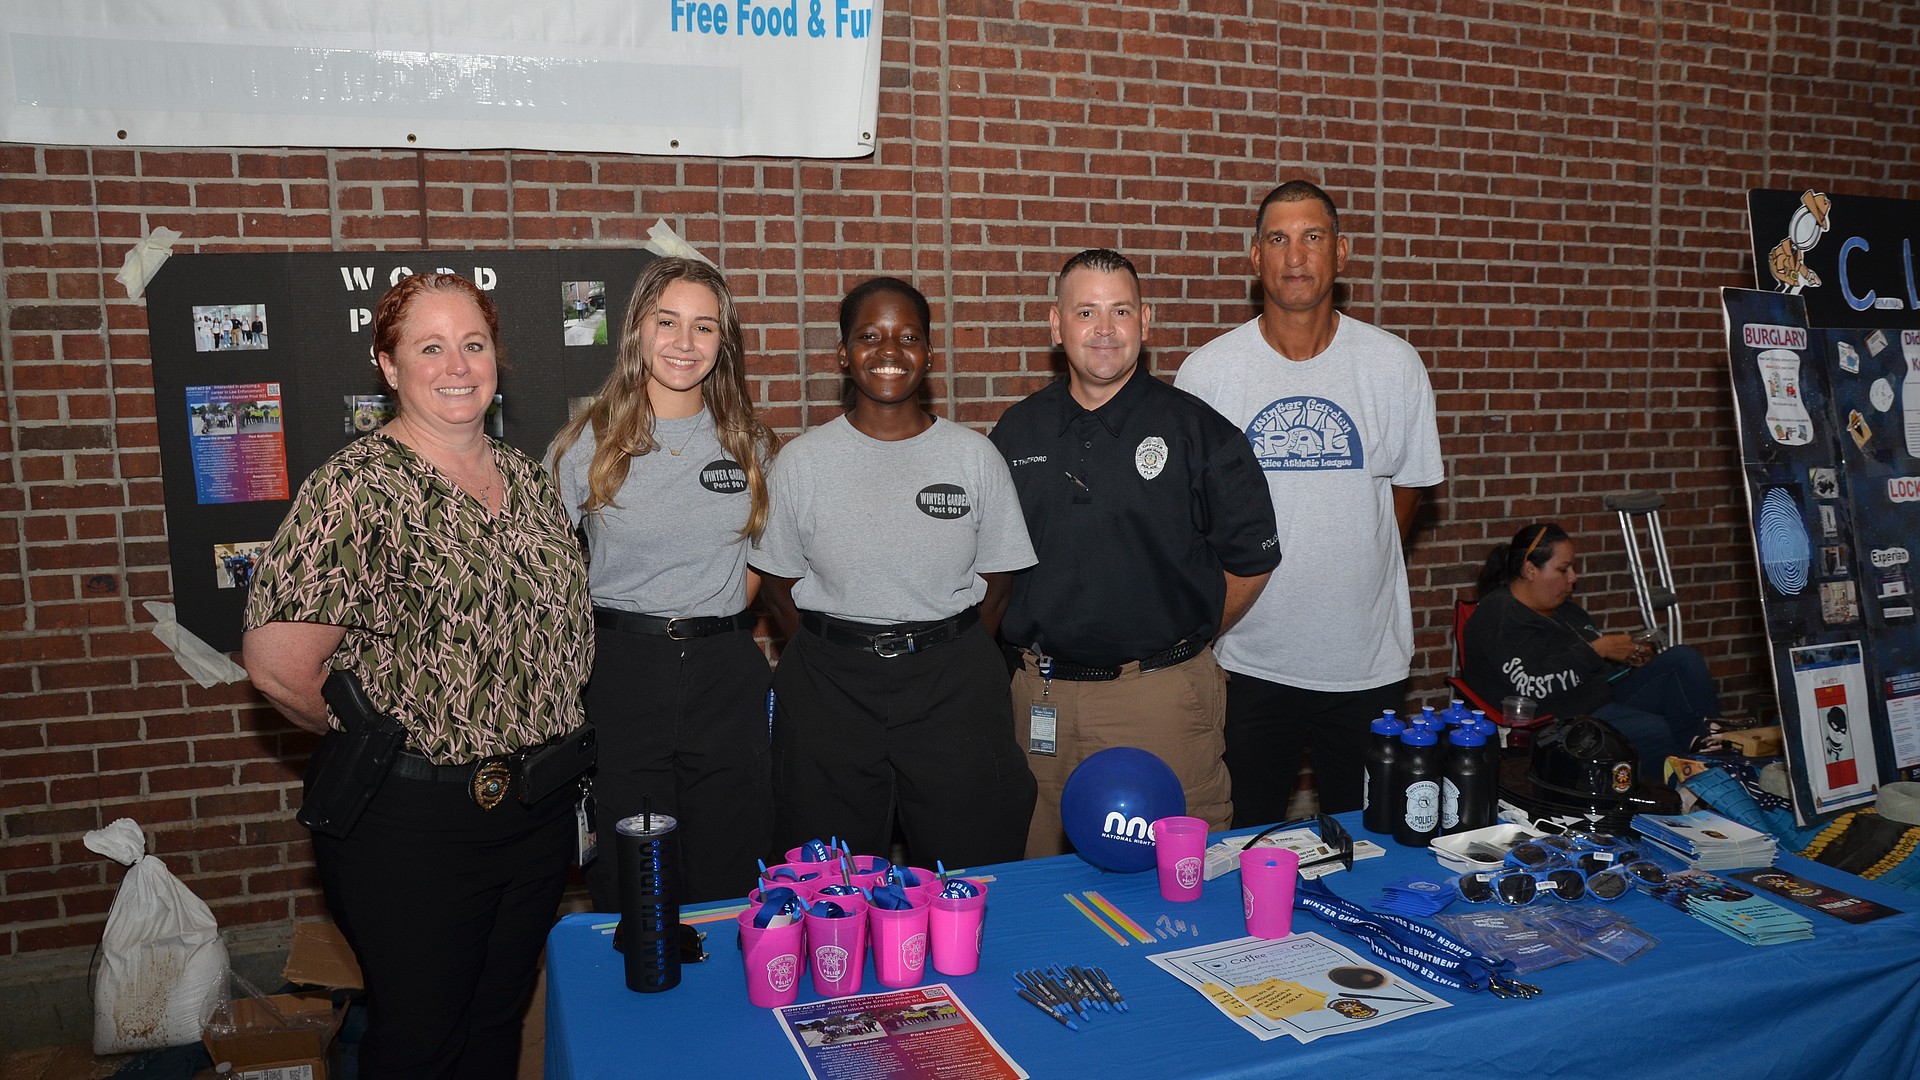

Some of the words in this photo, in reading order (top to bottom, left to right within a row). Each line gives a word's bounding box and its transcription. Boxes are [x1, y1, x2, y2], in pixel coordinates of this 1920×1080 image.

[671, 0, 728, 34] Free
[737, 0, 798, 37] Food
[807, 0, 826, 38] &
[340, 266, 498, 291] WOD
[1745, 327, 1806, 347] BURGLARY
[1306, 398, 1352, 434] Garden
[1283, 458, 1320, 468] Athletic
[1321, 458, 1352, 468] League
[703, 470, 728, 482] WINTER
[920, 493, 945, 505] WINTER
[1872, 549, 1908, 564] Experian
[1102, 833, 1132, 842] NATIONAL
[1303, 899, 1336, 917] WINTER
[1410, 923, 1437, 939] POLICE
[1437, 936, 1472, 957] GARDEN
[1230, 953, 1266, 964] Coffee
[1389, 955, 1420, 971] GARDEN
[1403, 946, 1460, 969] DEPARTMENT
[1420, 967, 1460, 988] WINTER
[865, 1002, 894, 1011] Explorer
[873, 994, 920, 1004] Enforcement?
[936, 1061, 981, 1071] Requirements
